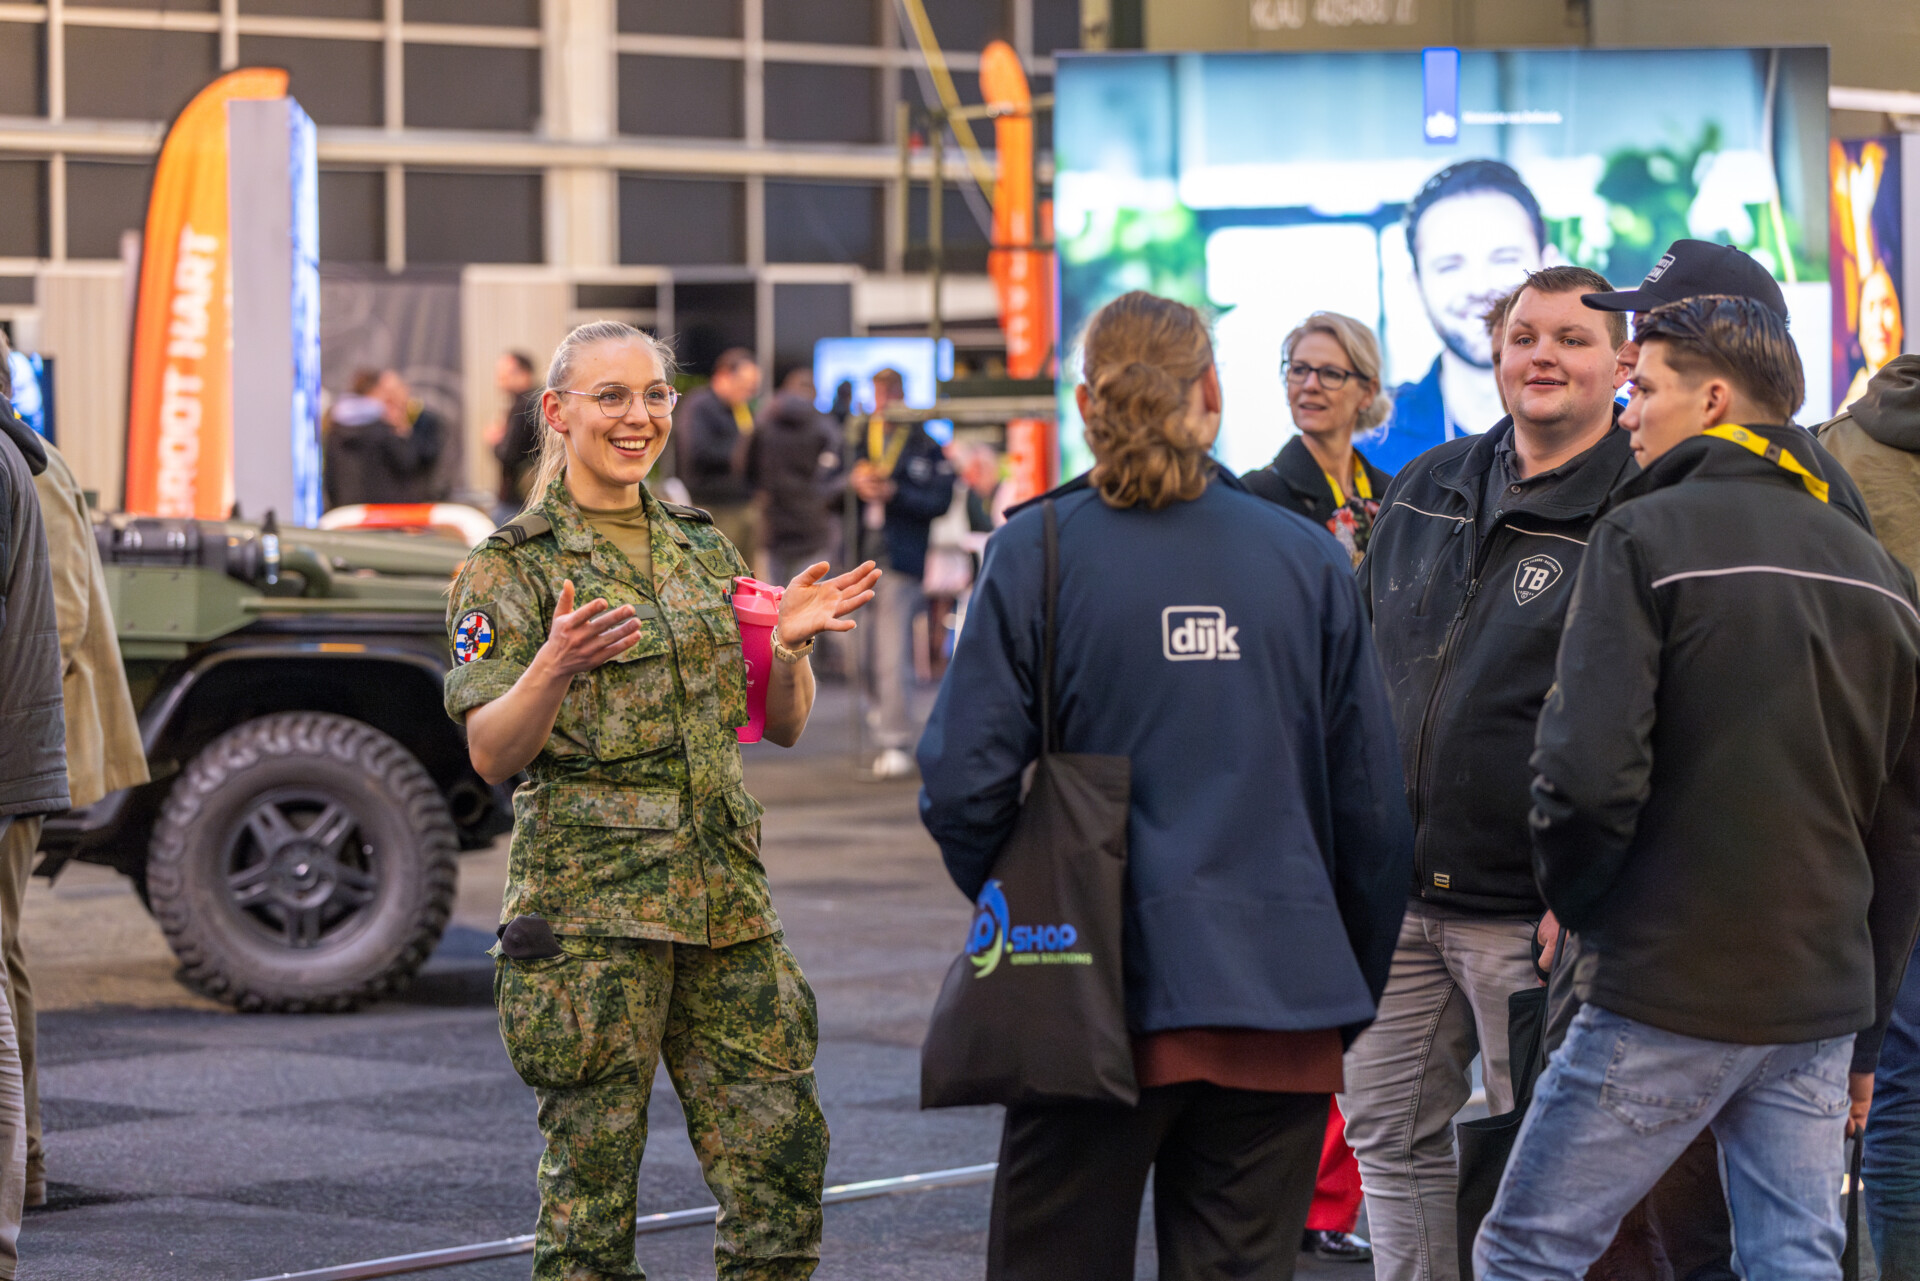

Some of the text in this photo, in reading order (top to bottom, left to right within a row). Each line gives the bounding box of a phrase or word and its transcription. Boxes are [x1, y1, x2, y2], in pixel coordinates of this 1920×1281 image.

[166, 223, 219, 360] HART
[1518, 566, 1550, 591] TB
[1171, 617, 1240, 659] dijk
